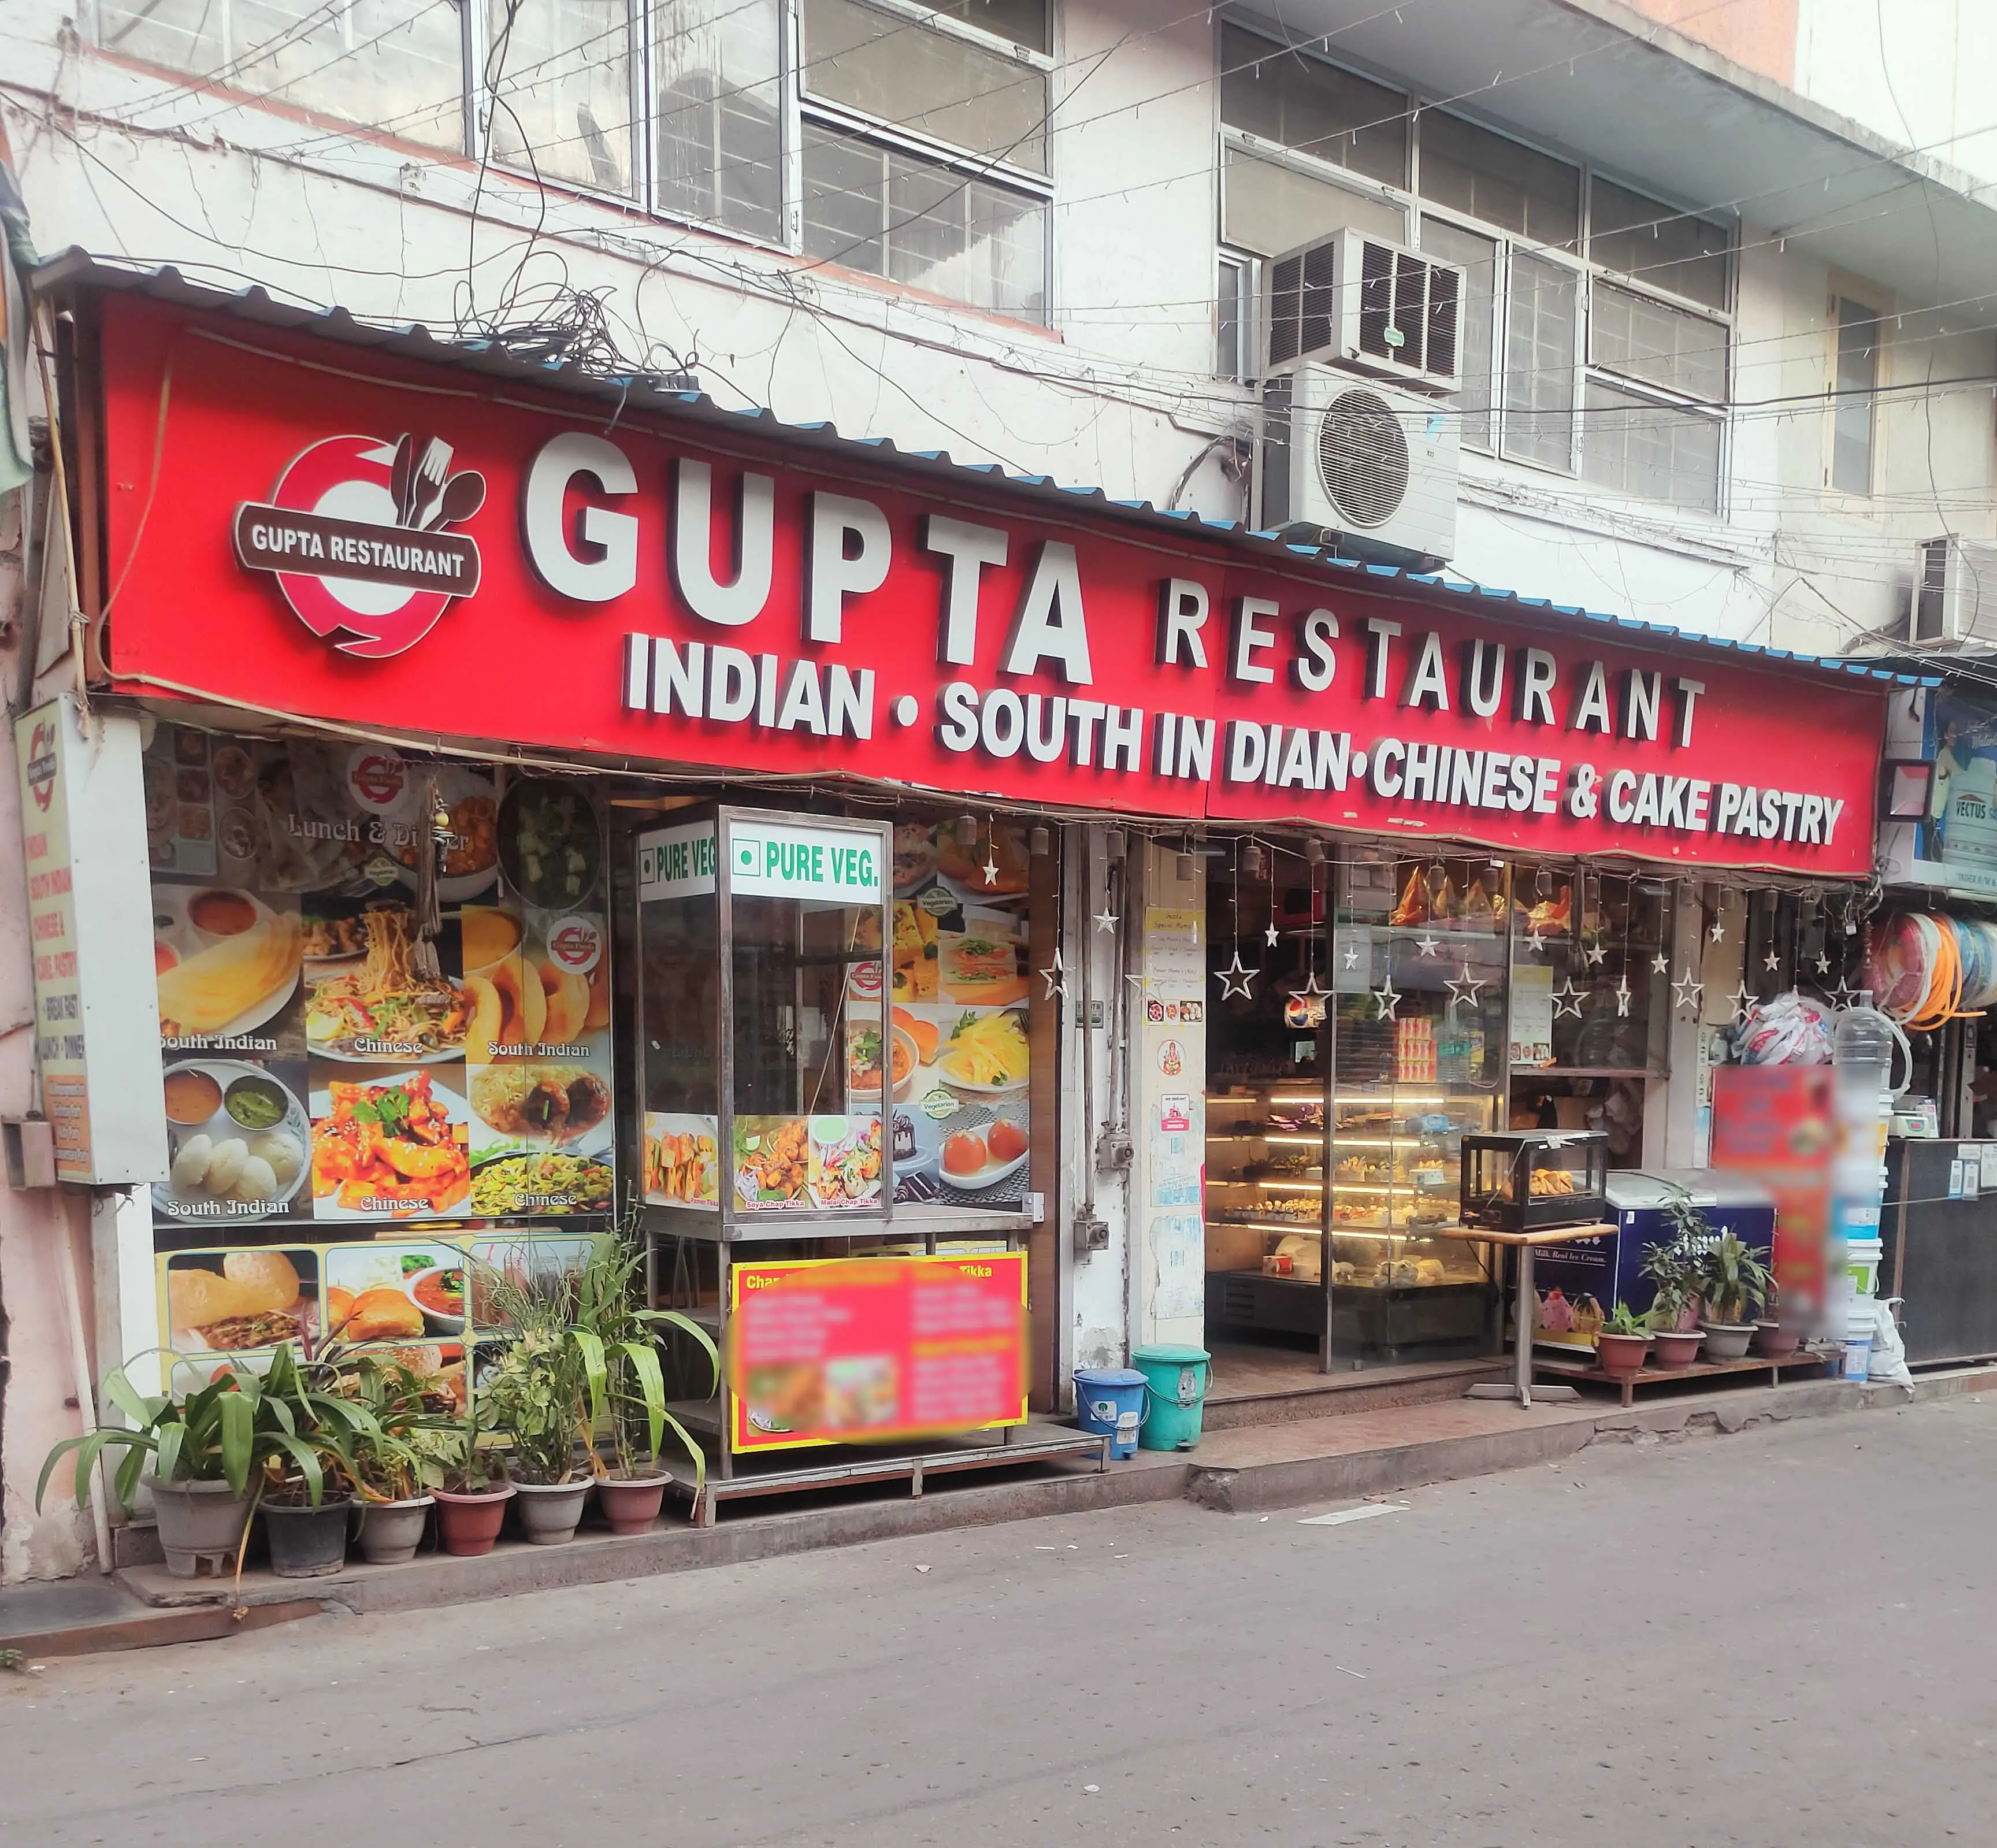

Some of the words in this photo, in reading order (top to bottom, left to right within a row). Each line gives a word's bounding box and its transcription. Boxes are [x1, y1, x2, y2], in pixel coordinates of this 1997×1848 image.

[252, 524, 324, 559] GUPTA
[330, 536, 465, 578] RESTAURANT
[520, 431, 1094, 686] GUPTA
[1157, 577, 1705, 748] RESTAURANT
[623, 632, 875, 740] INDIAN
[935, 681, 1144, 772] SOUTH
[1370, 738, 1562, 814] CHINESE
[1564, 763, 1597, 819] &
[1605, 769, 1710, 832] CAKE
[1715, 782, 1845, 845] PASTRY
[1957, 801, 1986, 819] VECTUS
[288, 814, 361, 841] Lunch
[369, 821, 385, 844] &
[656, 840, 688, 882] PURE
[766, 842, 823, 882] PURE
[830, 847, 879, 887] VEG.
[213, 1034, 278, 1050] Indian
[354, 1038, 423, 1054] Chinese
[488, 1041, 533, 1056] South
[537, 1042, 590, 1057] Indian
[924, 1101, 955, 1110] Vegetarian
[167, 1198, 222, 1216] South
[226, 1199, 290, 1215] Indian
[360, 1196, 429, 1211] Chinese
[746, 1201, 764, 1209] Soya
[765, 1201, 785, 1210] Chap
[840, 1198, 859, 1207] Chap
